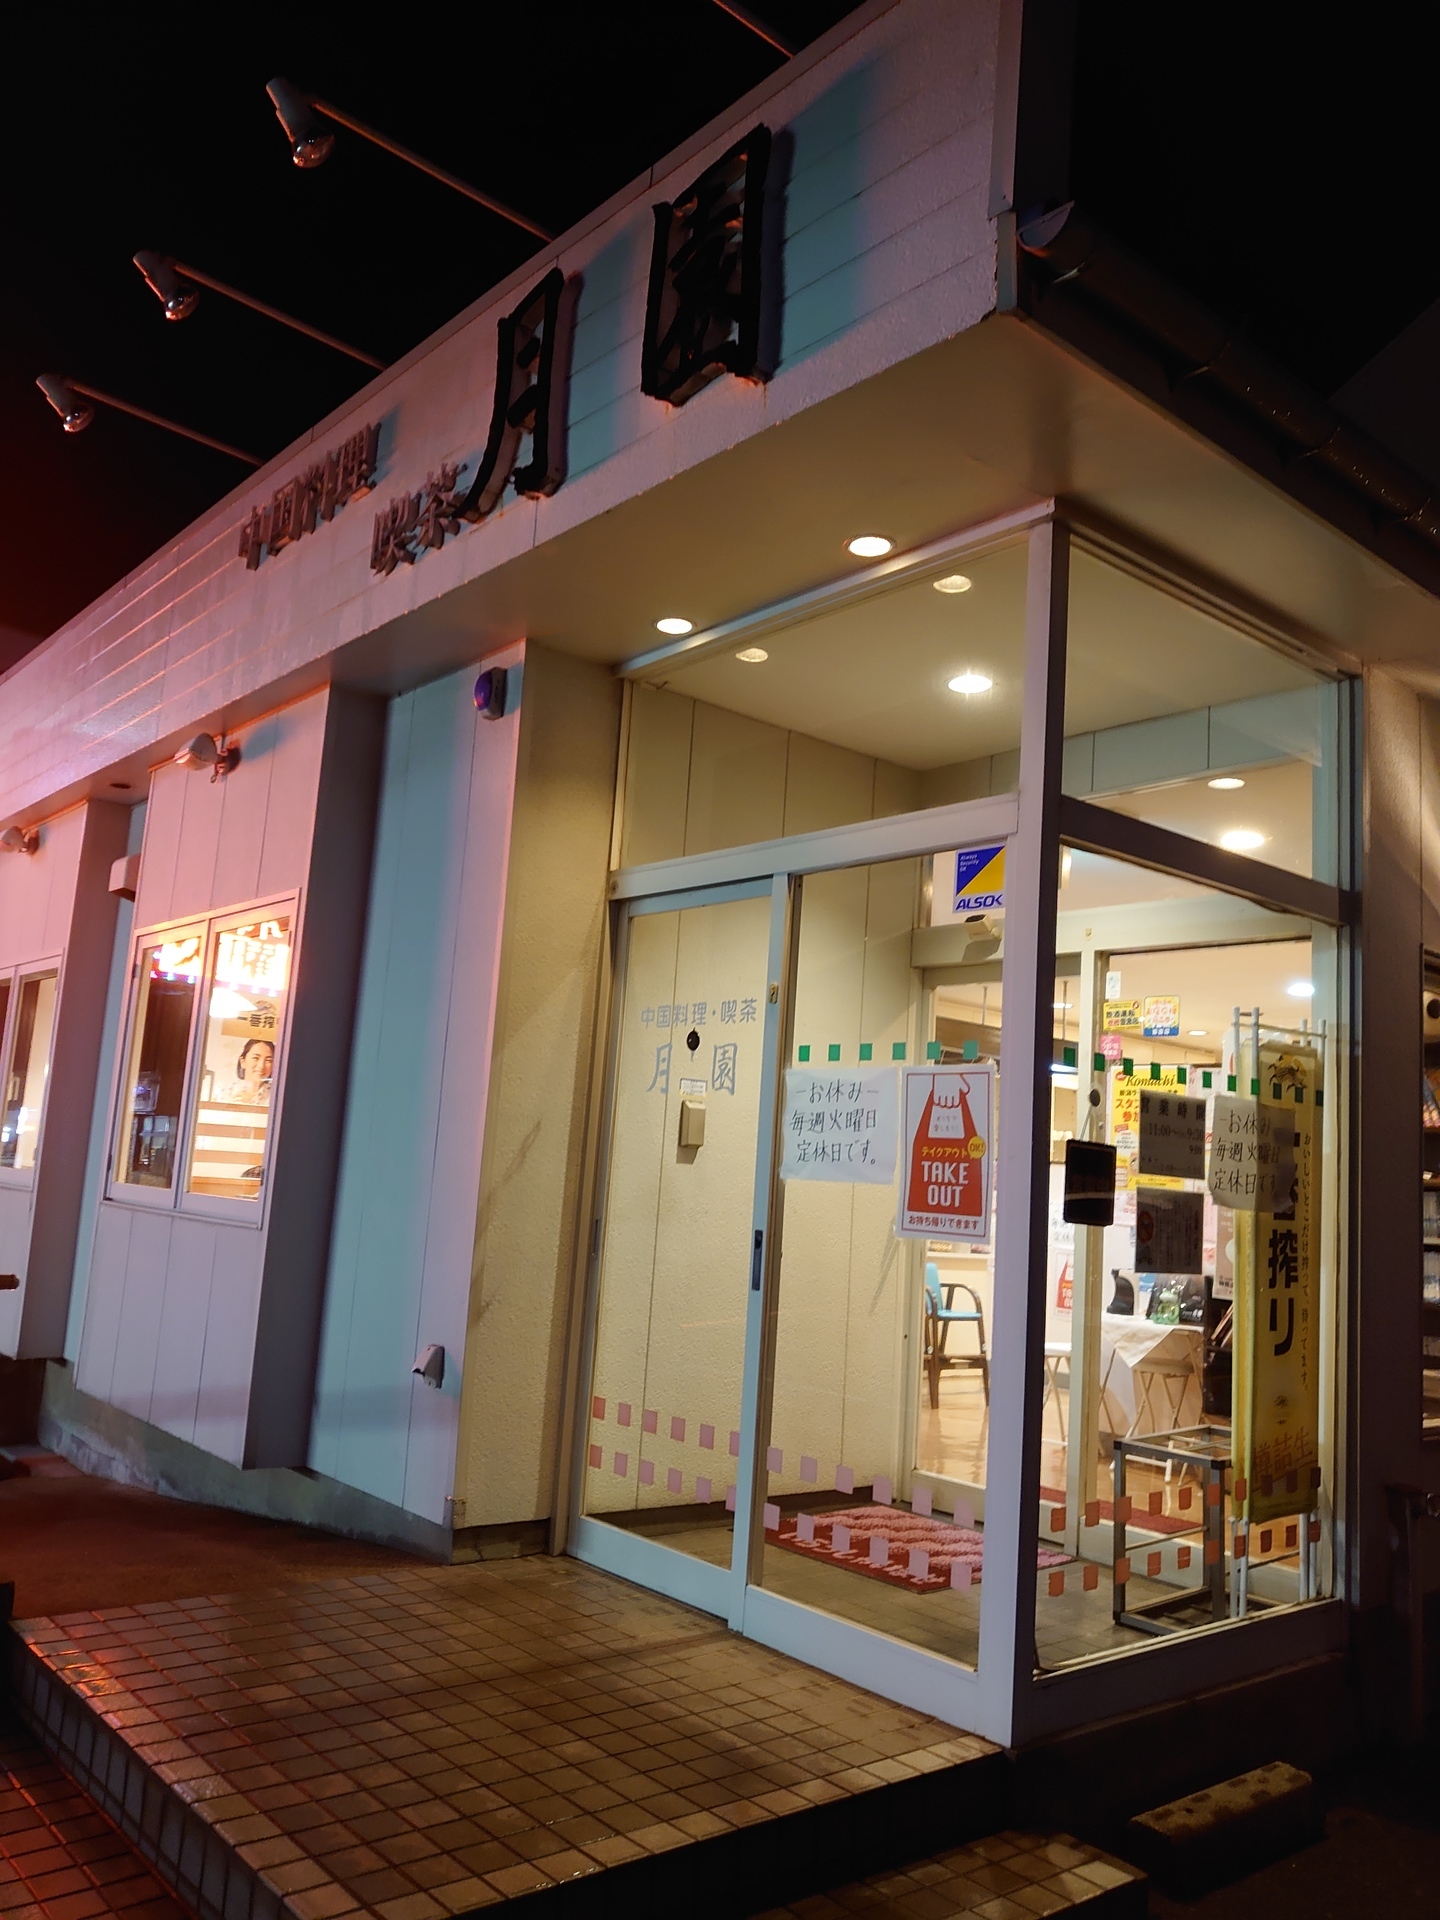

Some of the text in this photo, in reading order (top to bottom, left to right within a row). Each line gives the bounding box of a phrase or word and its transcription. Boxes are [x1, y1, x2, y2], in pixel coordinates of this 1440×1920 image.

[956, 894, 1003, 911] ALSOK
[789, 1109, 878, 1134] 毎週火曜日
[796, 1140, 877, 1166] 定休日です。
[921, 1147, 969, 1159] テイクアウト
[921, 1160, 970, 1184] TAKE
[927, 1184, 963, 1207] OUT
[908, 1215, 980, 1231] お持ち帰りできます
